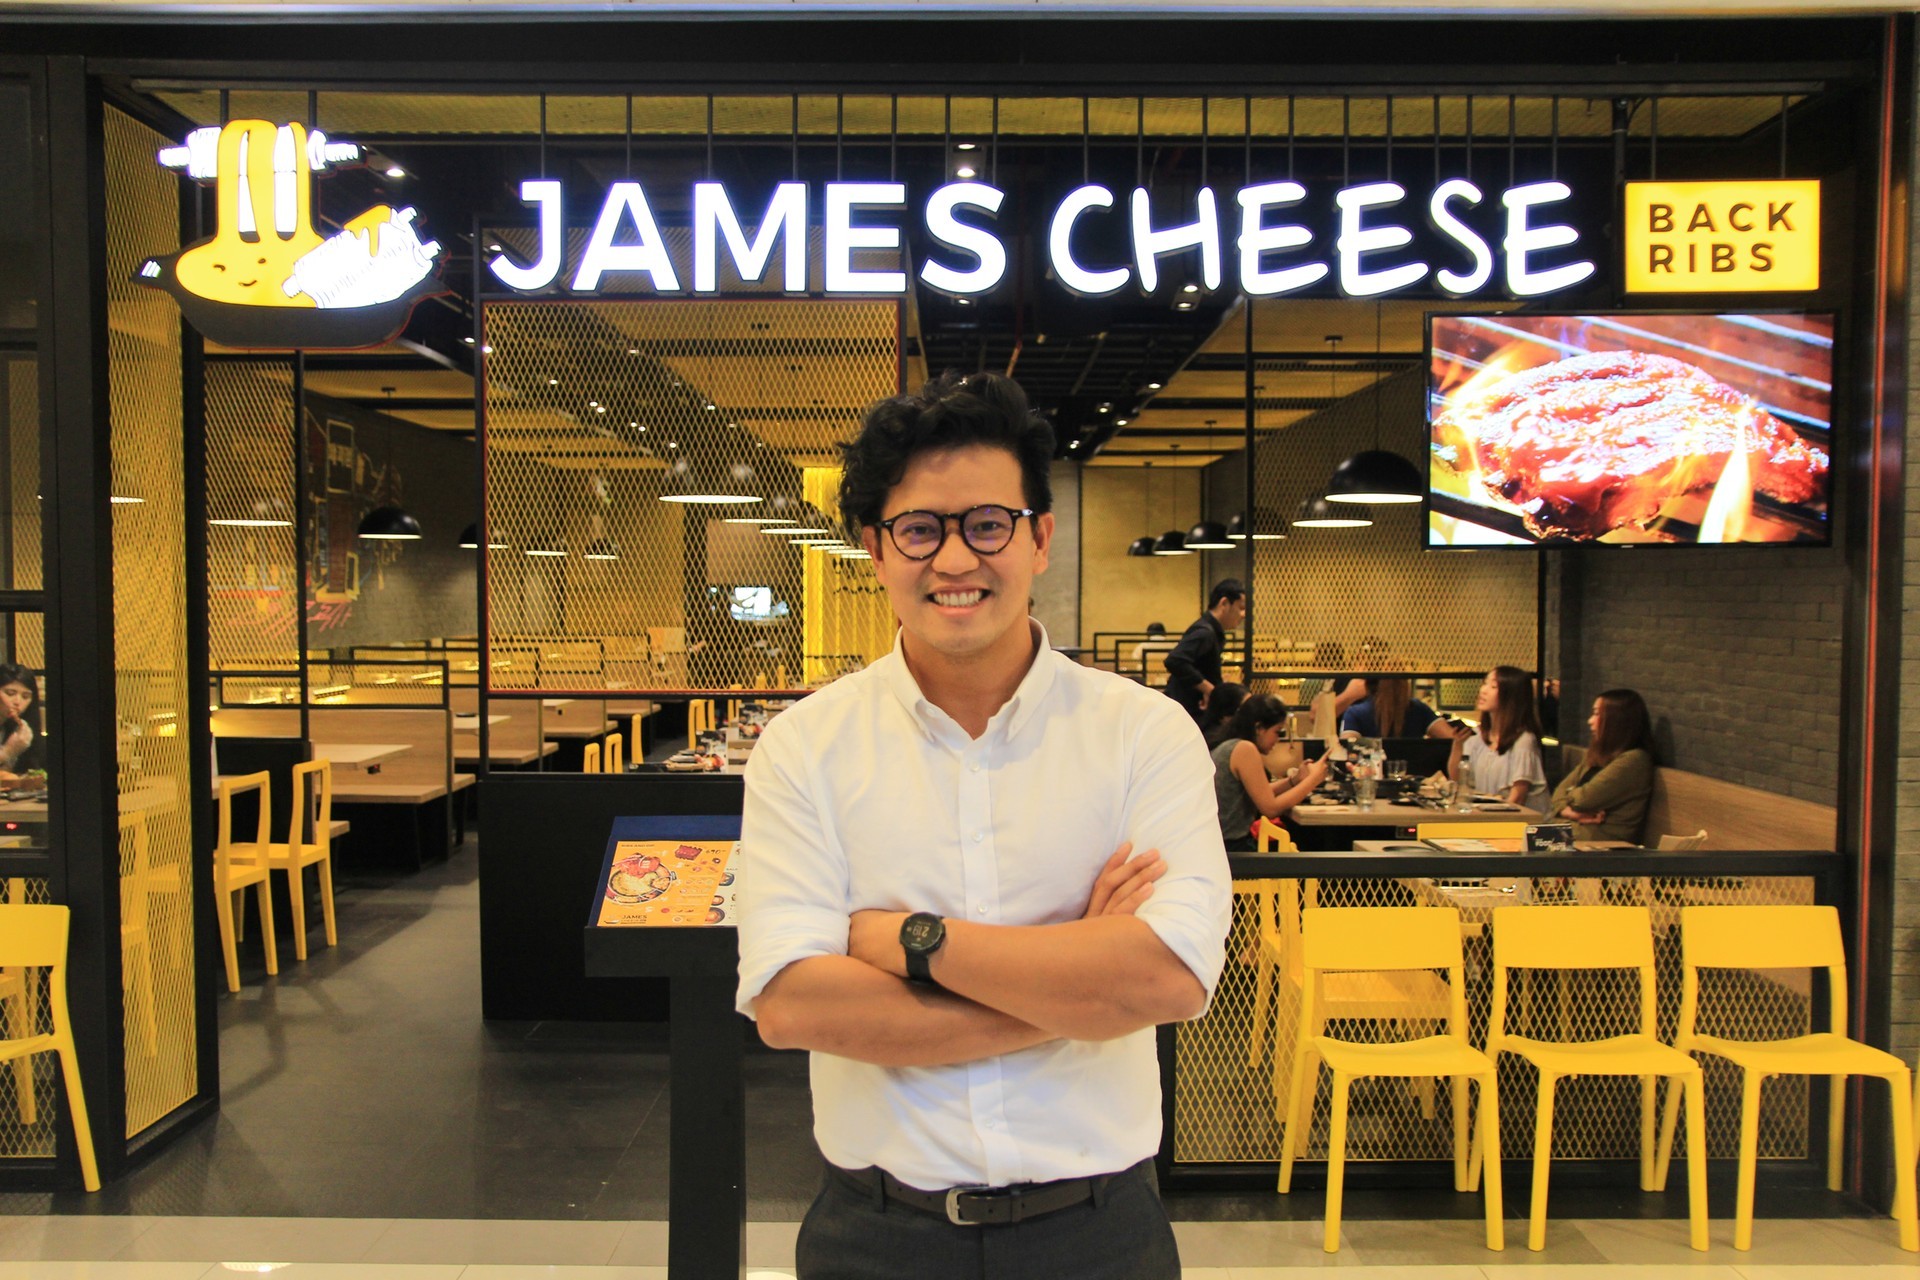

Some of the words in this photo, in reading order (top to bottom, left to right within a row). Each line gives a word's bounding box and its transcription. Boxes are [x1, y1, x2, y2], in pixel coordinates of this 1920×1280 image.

[1649, 202, 1796, 233] BACK
[488, 180, 1007, 295] JAMES
[1049, 178, 1597, 297] CHEESE
[1649, 243, 1774, 273] RIBS
